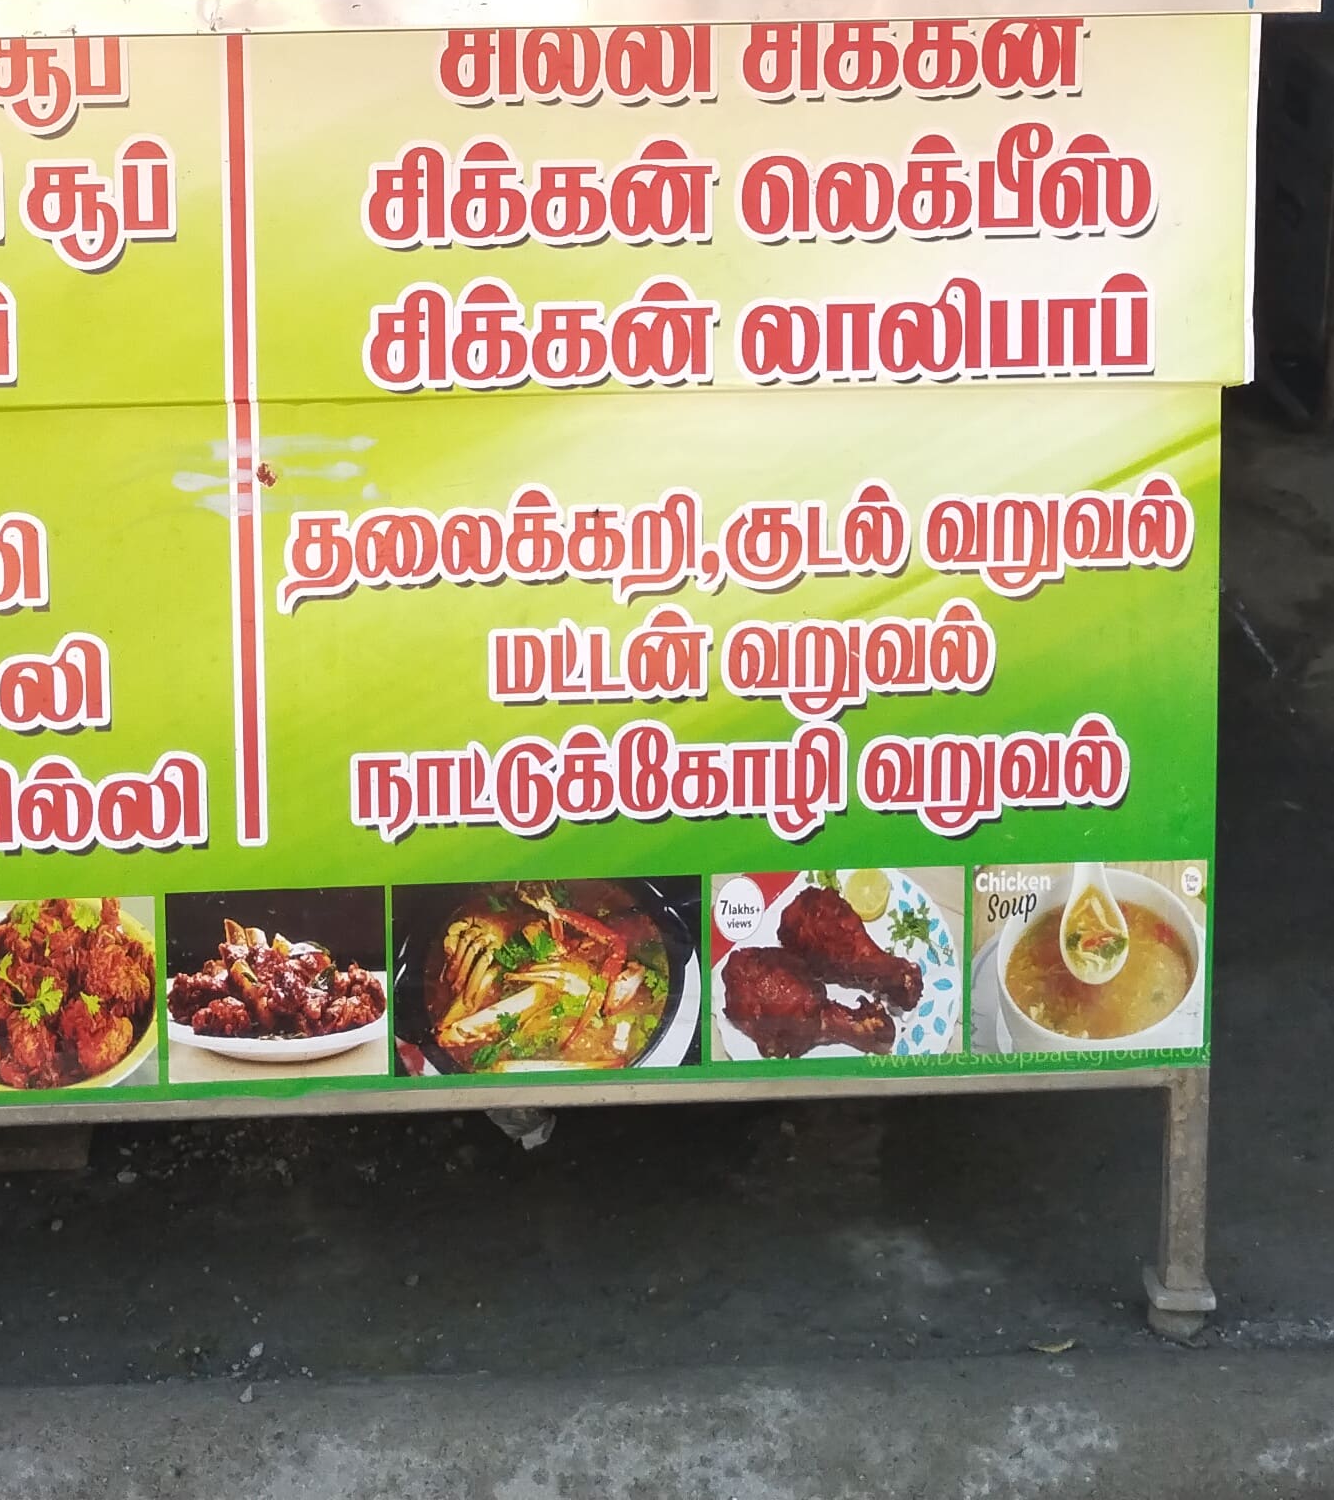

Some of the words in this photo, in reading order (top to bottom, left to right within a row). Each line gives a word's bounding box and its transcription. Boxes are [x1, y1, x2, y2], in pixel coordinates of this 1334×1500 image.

[26, 140, 170, 263] சூப்
[368, 139, 714, 241] சிக்கன்
[741, 122, 1153, 236] லெக்பீஸ்
[369, 281, 714, 384] சிக்கன்
[741, 272, 1149, 376] லாலிபாப்
[927, 479, 1188, 590] வறுவல்
[496, 610, 707, 696] மட்டன்
[728, 605, 989, 716] வறுவல்
[357, 726, 842, 834] நாட்டுக்கோழி
[864, 720, 1123, 830] வறுவல்
[726, 918, 753, 930] views
[975, 870, 1052, 895] Chicken
[986, 891, 1039, 925] Soup
